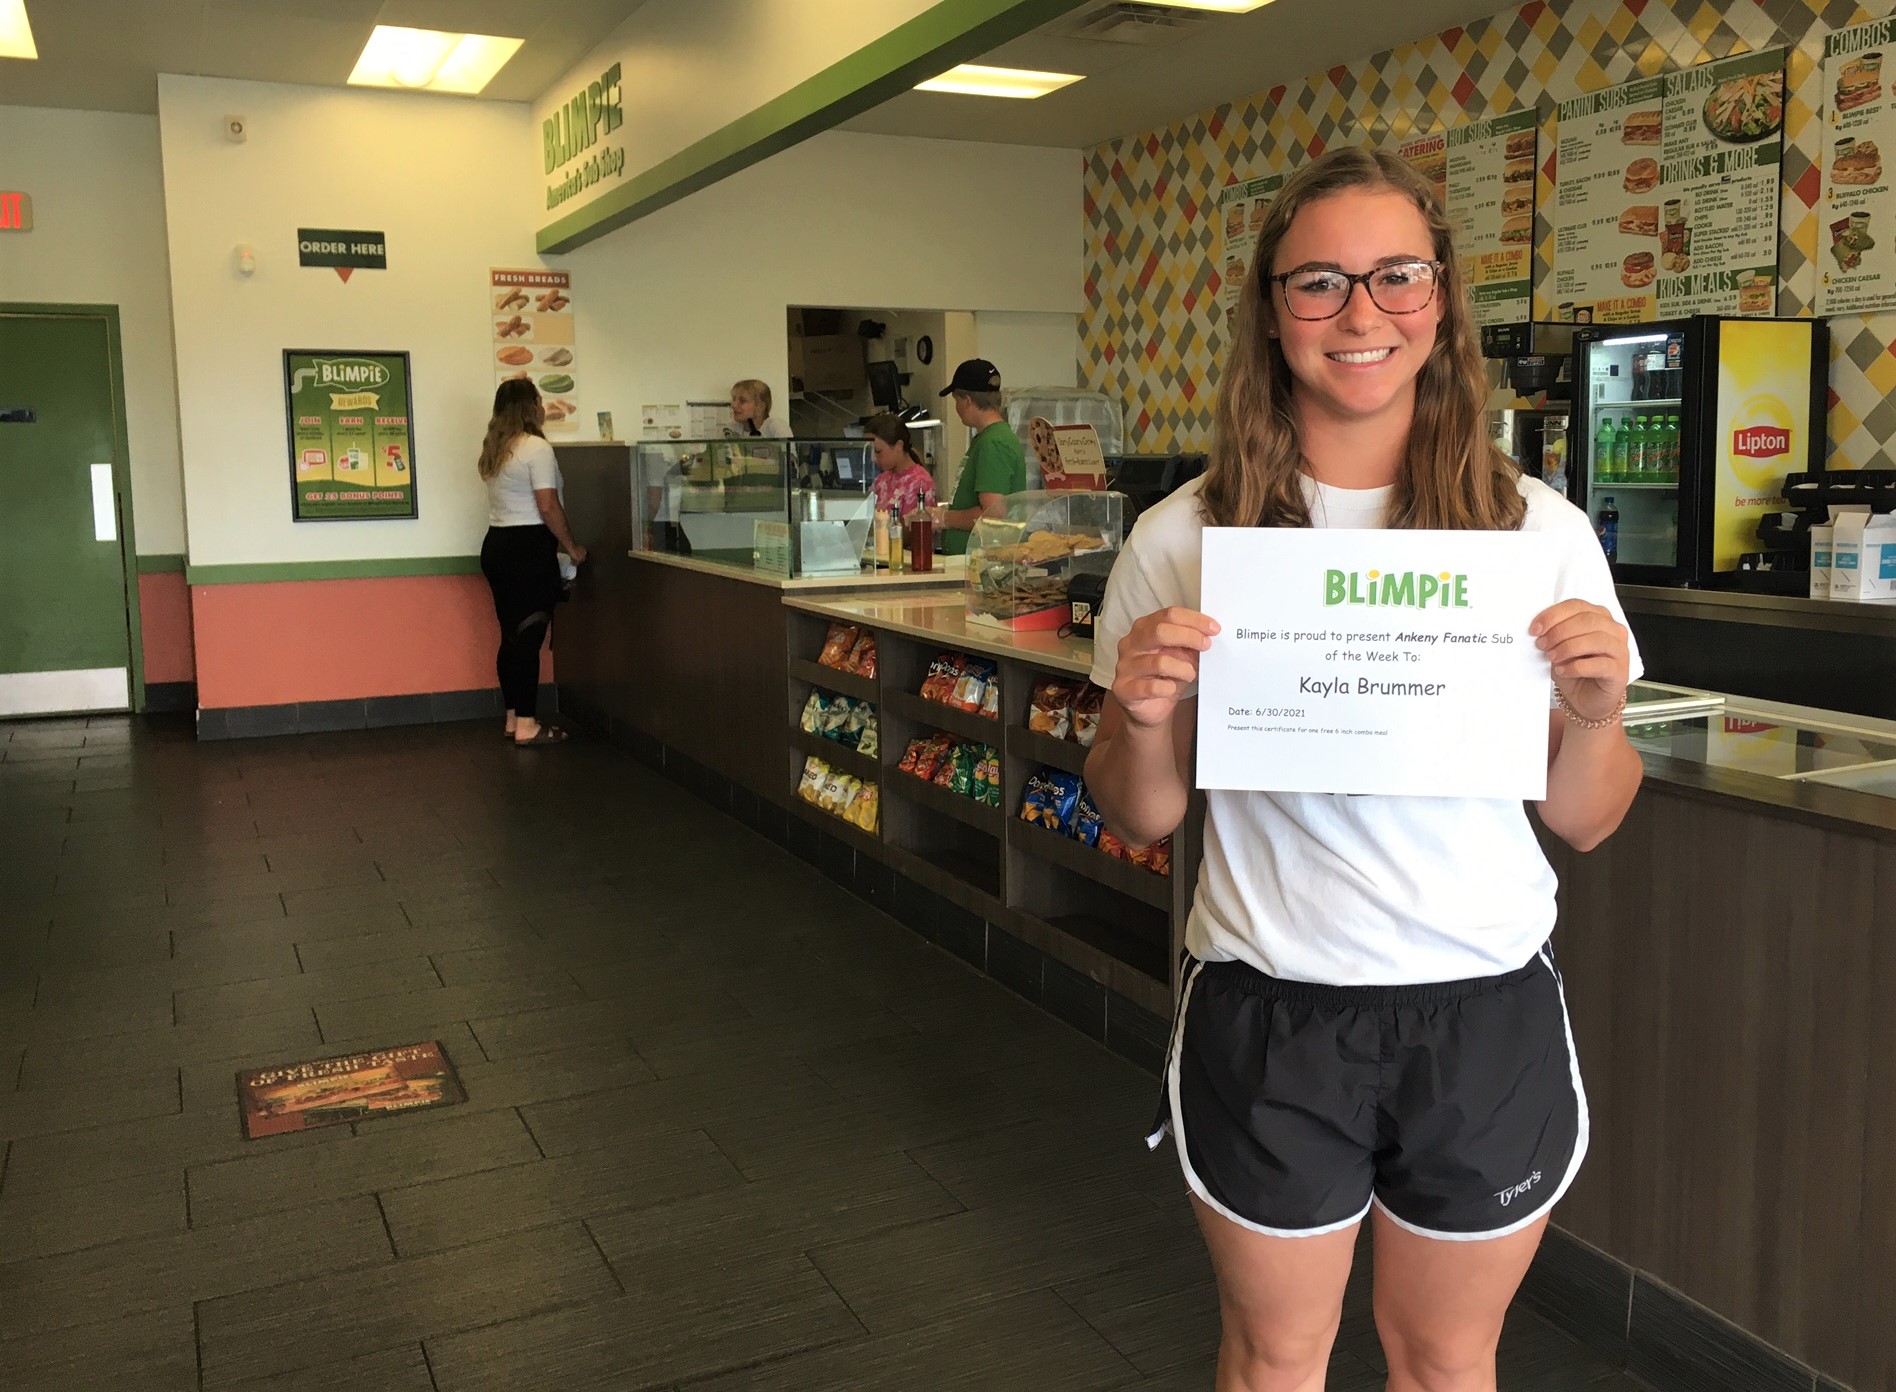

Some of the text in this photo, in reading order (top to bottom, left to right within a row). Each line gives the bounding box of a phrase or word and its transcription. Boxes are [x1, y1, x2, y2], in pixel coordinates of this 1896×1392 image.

[1830, 19, 1891, 56] COMBOS
[1667, 64, 1714, 97] SALADS
[1561, 94, 1595, 122] PANINI
[1600, 86, 1628, 113] SUBS
[543, 62, 623, 175] BLIMPIE
[1450, 128, 1464, 148] HOT
[1468, 120, 1492, 142] SUBS
[1664, 146, 1758, 184] DRINKS & MORE
[546, 146, 625, 211] America's Sub Shop
[1828, 187, 1833, 199] 3
[1836, 185, 1889, 200] BUFFALO CHICKEN
[300, 240, 384, 256] ORDER HERE
[494, 274, 567, 284] FRESH BREADS
[1660, 270, 1732, 300] KIDS MEALS
[1832, 274, 1881, 285] CHICKEN CAESAR
[1597, 296, 1646, 312] MAKE IT A COMBO
[338, 395, 372, 406] REWARDS
[300, 416, 321, 425] JOIN
[339, 416, 364, 425] EARN
[1738, 432, 1786, 454] Lipton
[306, 490, 404, 500] GET 25 BONUS POINTS
[1734, 496, 1746, 507] be
[1746, 498, 1770, 506] more
[1236, 628, 1514, 646] Blimpie is proud to present Ankeny Fanatic Sub
[1325, 650, 1421, 662] of the Week To:
[1300, 676, 1446, 698] Kayla Brummer
[1228, 707, 1306, 718] Date: 6/30/2021
[1493, 1170, 1542, 1206] Tyler's
